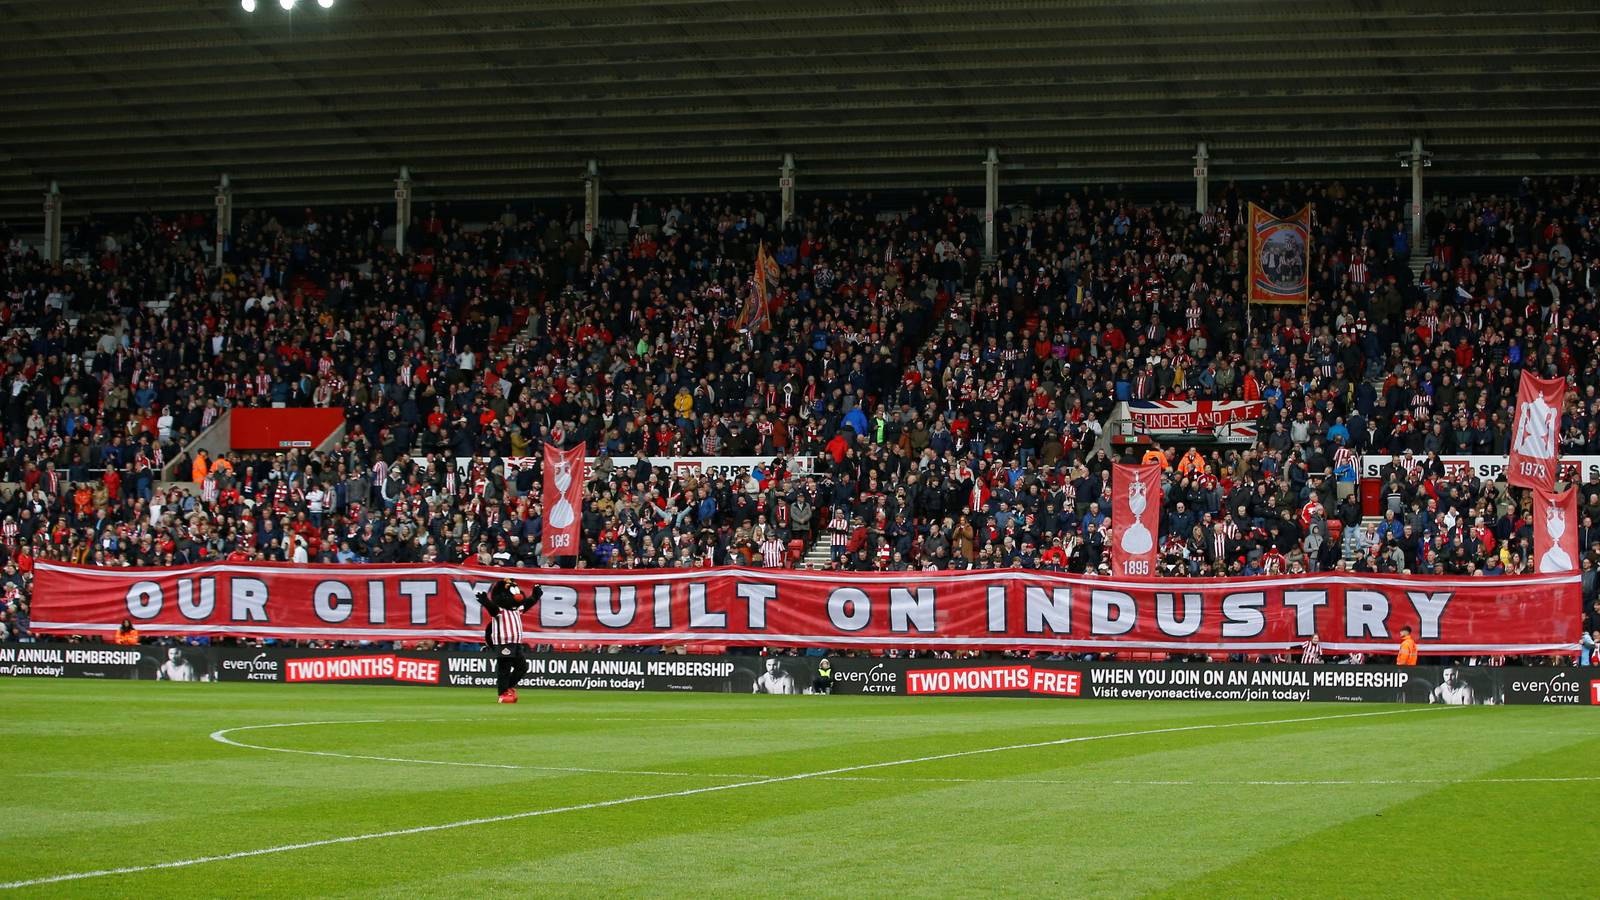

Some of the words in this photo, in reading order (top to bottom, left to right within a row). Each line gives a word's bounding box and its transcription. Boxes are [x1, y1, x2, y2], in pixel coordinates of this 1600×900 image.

[1519, 460, 1546, 479] 1973
[1122, 560, 1149, 575] 1895
[125, 577, 270, 623] OUR
[313, 578, 493, 627] CITY
[539, 581, 778, 630] BUILT
[826, 585, 937, 634] ON
[986, 584, 1455, 640] INDUSTRY
[0, 648, 15, 662] AN
[18, 648, 63, 663] ANNUAL
[65, 650, 142, 665] MEMBERSHIP
[222, 653, 278, 672] everyone
[34, 665, 64, 677] today!
[287, 660, 325, 680] TWO
[326, 657, 394, 678] MONTHS
[447, 657, 487, 672] WHEN
[548, 660, 567, 674] ON
[569, 660, 588, 674] AN
[591, 660, 644, 676] ANNUAL
[647, 661, 735, 677] MEMBERSHIP
[834, 663, 897, 684] everyone
[247, 673, 278, 681] ACTIVE
[449, 674, 473, 685] Visit
[610, 678, 645, 690] today!
[908, 672, 950, 692] TWO
[952, 668, 1029, 690] MONTHS
[1090, 669, 1134, 684] WHEN
[1137, 669, 1166, 684] YOU
[1168, 670, 1200, 685] JOIN
[1203, 670, 1224, 685] ON
[1227, 671, 1248, 685] AN
[1251, 671, 1310, 686] ANNUAL
[1313, 672, 1409, 688] MEMBERSHIP
[1512, 672, 1580, 694] everyone
[862, 685, 896, 693] ACTIVE
[1092, 686, 1118, 698] Visit
[1121, 687, 1269, 702] everyoneactive.com/join
[1272, 689, 1310, 702] today!
[1542, 695, 1580, 703] ACTIVE
